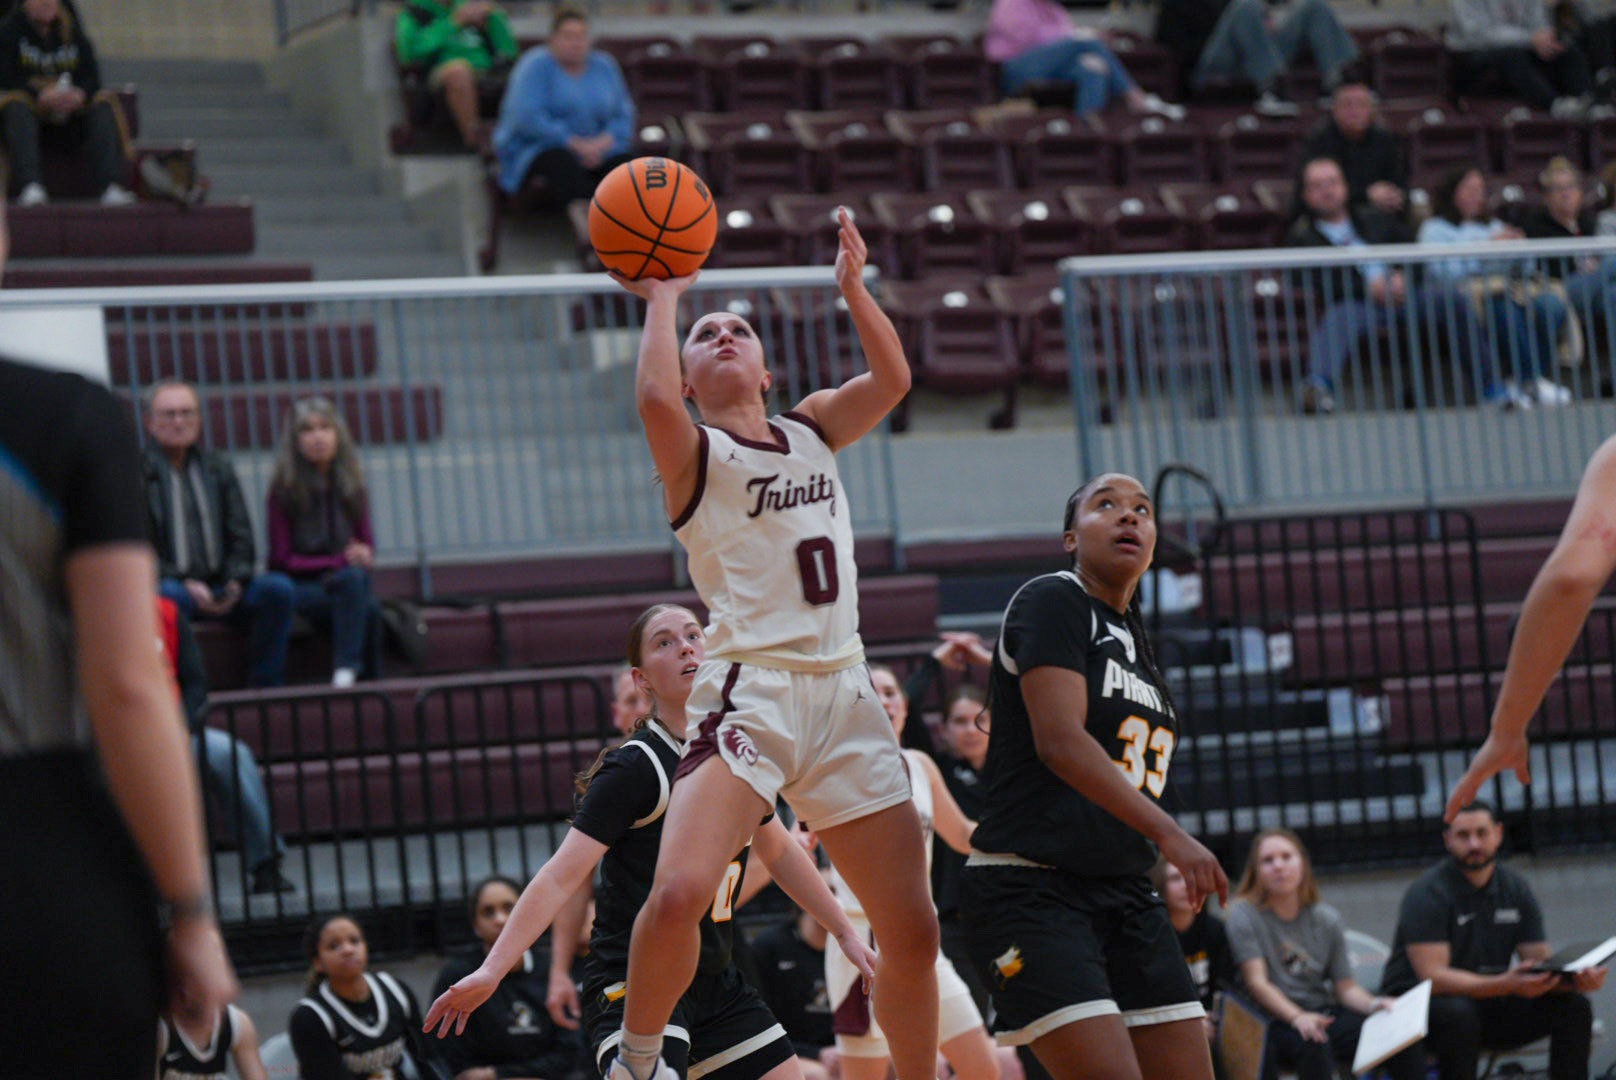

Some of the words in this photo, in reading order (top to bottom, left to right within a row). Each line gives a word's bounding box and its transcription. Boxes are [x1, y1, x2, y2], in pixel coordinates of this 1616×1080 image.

[747, 473, 836, 518] Trinity
[796, 536, 839, 608] 0
[1112, 715, 1174, 799] 33
